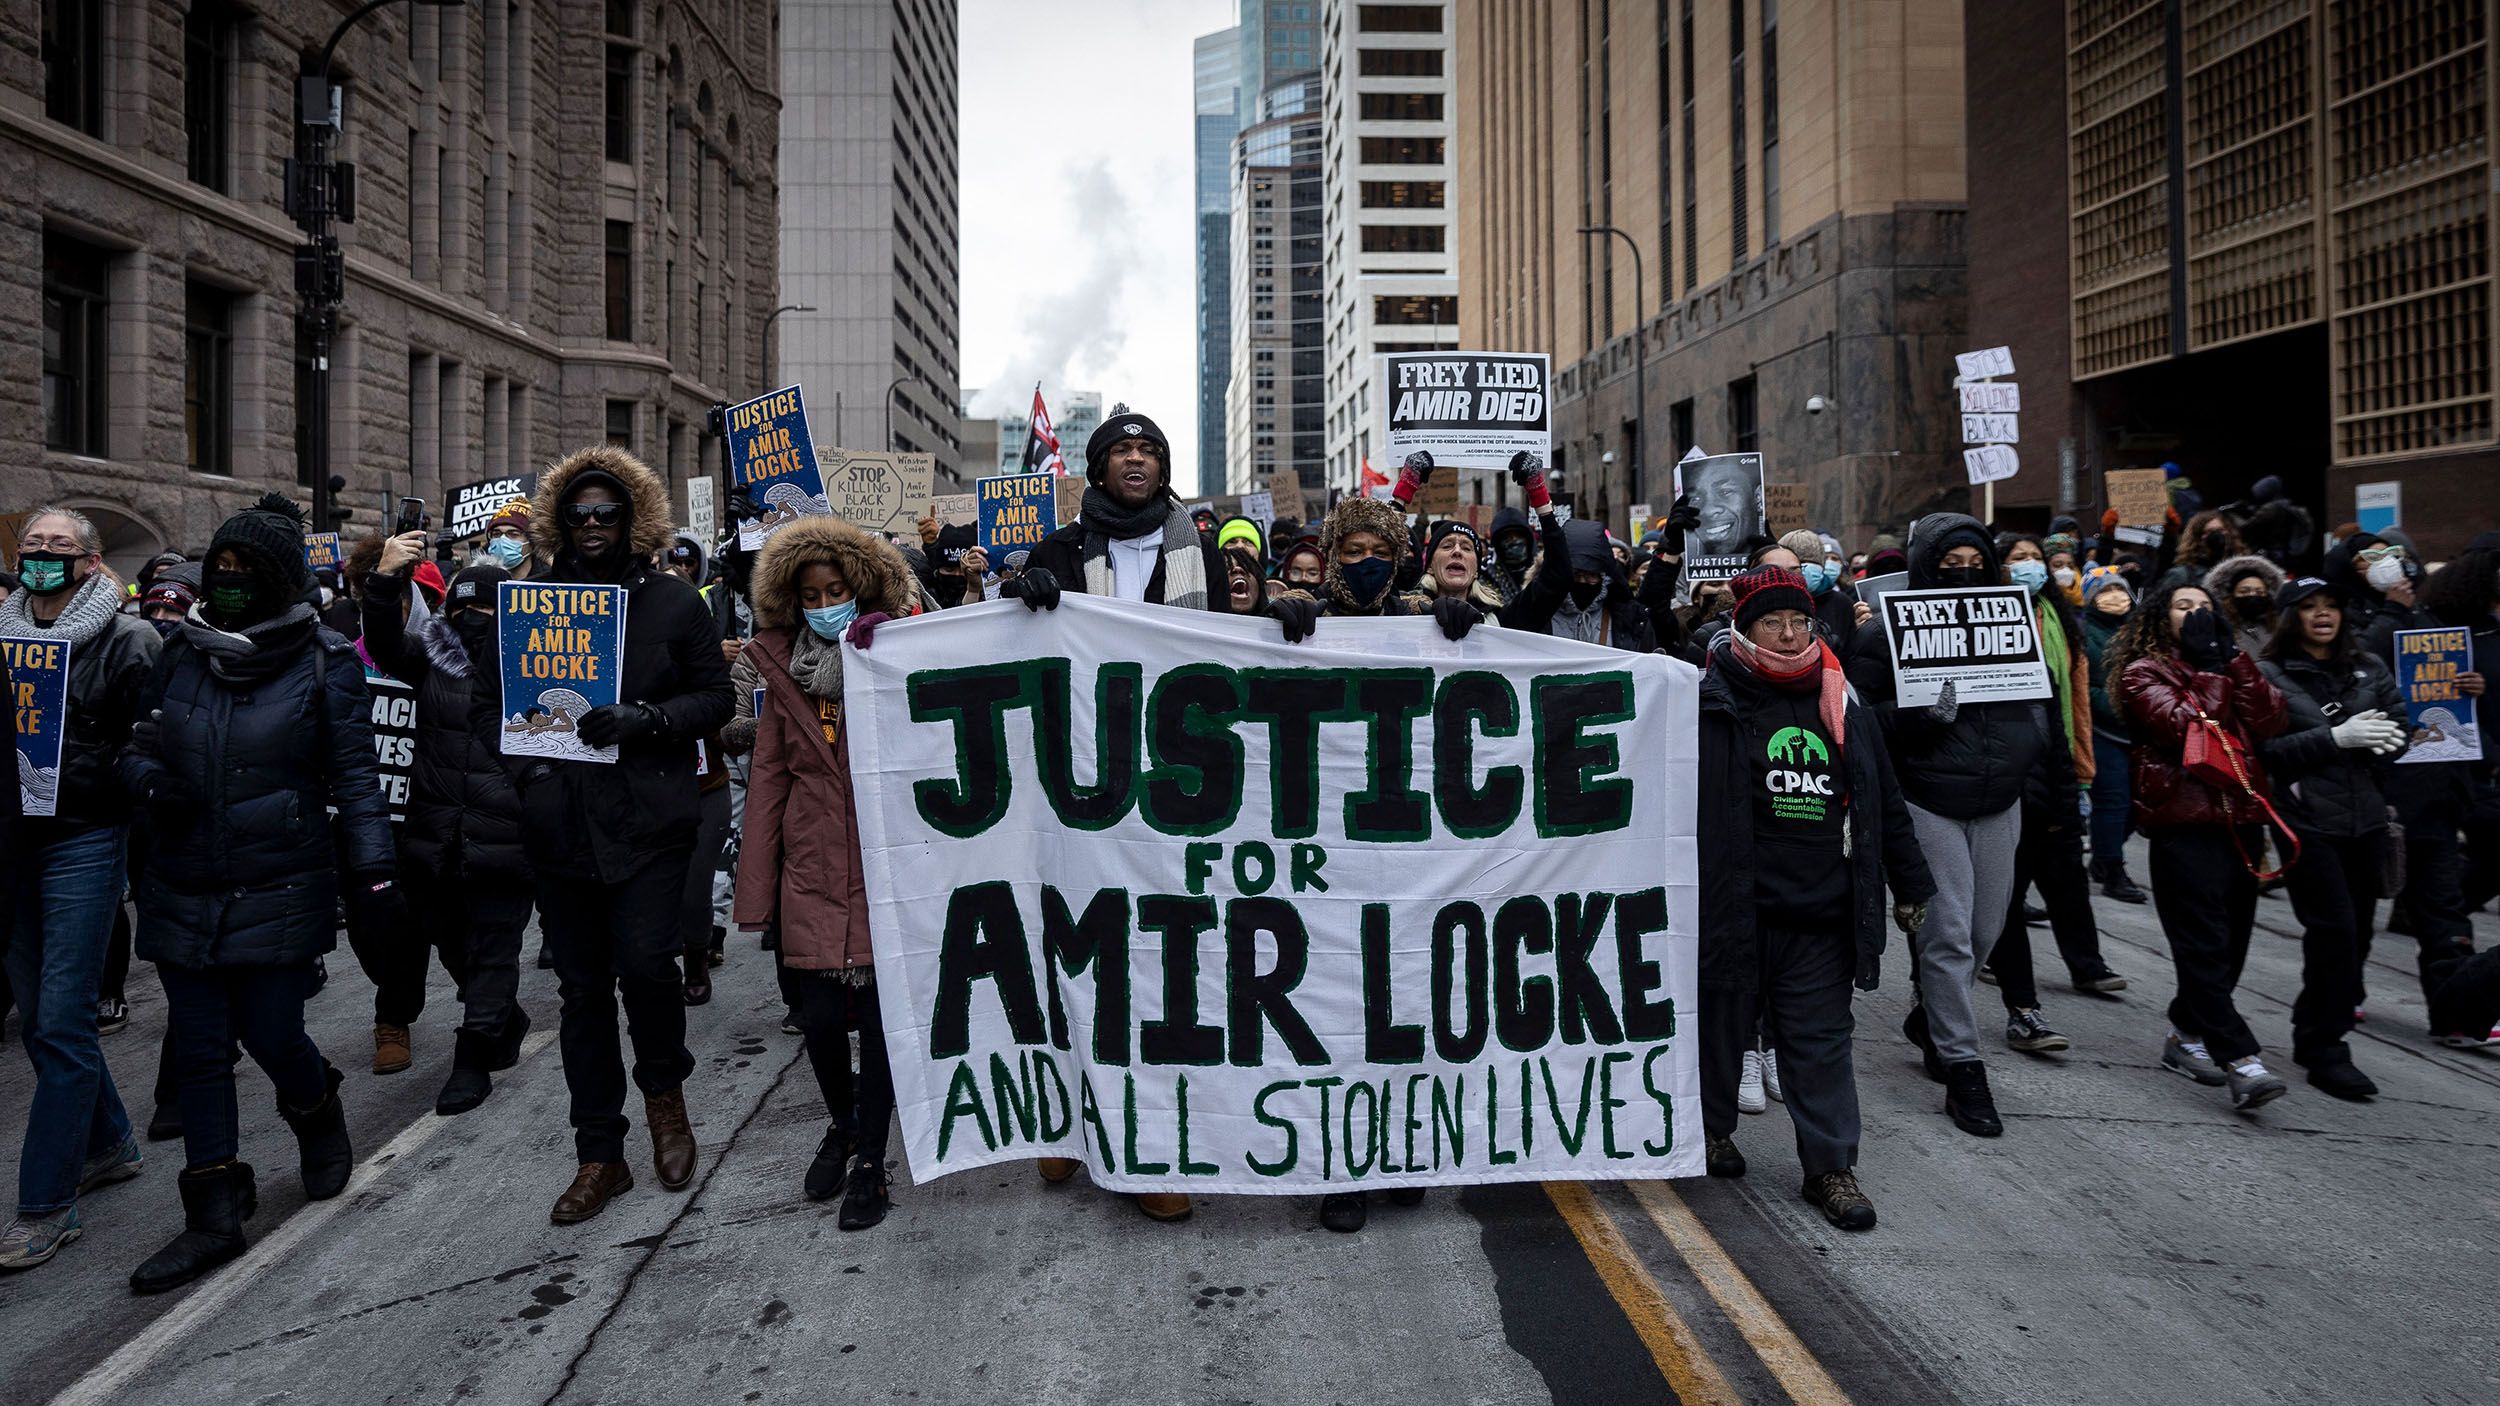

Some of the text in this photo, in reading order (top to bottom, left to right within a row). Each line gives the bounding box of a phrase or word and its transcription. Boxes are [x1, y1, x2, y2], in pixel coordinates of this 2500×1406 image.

[1398, 362, 1541, 392] FREY LIED,
[733, 391, 799, 432] JUSTICE
[1393, 391, 1543, 422] AMIR DIED
[759, 421, 774, 434] FOR
[1964, 417, 2016, 441] BLACK
[749, 428, 792, 459] AMIR
[745, 448, 803, 483] LOCKE
[848, 467, 886, 482] STOP
[460, 479, 521, 502] BLACK
[838, 482, 891, 493] KILLING
[907, 481, 926, 490] Amir
[984, 477, 1050, 500] JUSTICE
[846, 495, 884, 506] BLACK
[1009, 496, 1024, 507] FOR
[843, 507, 886, 522] PEOPLE
[996, 506, 1038, 526] AMIR
[453, 515, 492, 538] MAT
[991, 525, 1044, 546] LOCKE
[304, 536, 335, 546] USTICE
[944, 547, 967, 556] BLAC
[1690, 557, 1736, 567] JUSTICE
[1691, 568, 1748, 578] AMIR LOC
[509, 589, 611, 615] JUSTICE
[1894, 596, 2027, 627] FREY LIED,
[549, 615, 571, 627] FOR
[528, 628, 592, 653] AMIR
[1900, 625, 2032, 660] AMIR DIED
[2401, 632, 2466, 654] JUSTICE
[1, 642, 60, 669] TICE
[521, 654, 599, 680] LOCKE
[2414, 662, 2457, 682] AMIR
[374, 734, 415, 767] VES
[907, 657, 1637, 843] JUSTICE
[1766, 769, 1834, 795] CPAC
[1772, 802, 1826, 815] Accountability
[1775, 810, 1824, 821] Commission
[1184, 841, 1328, 893] FOR
[931, 880, 1676, 1068] AMIR LOCKE
[936, 1044, 1674, 1181] AND ALL STOLEN LIVES
